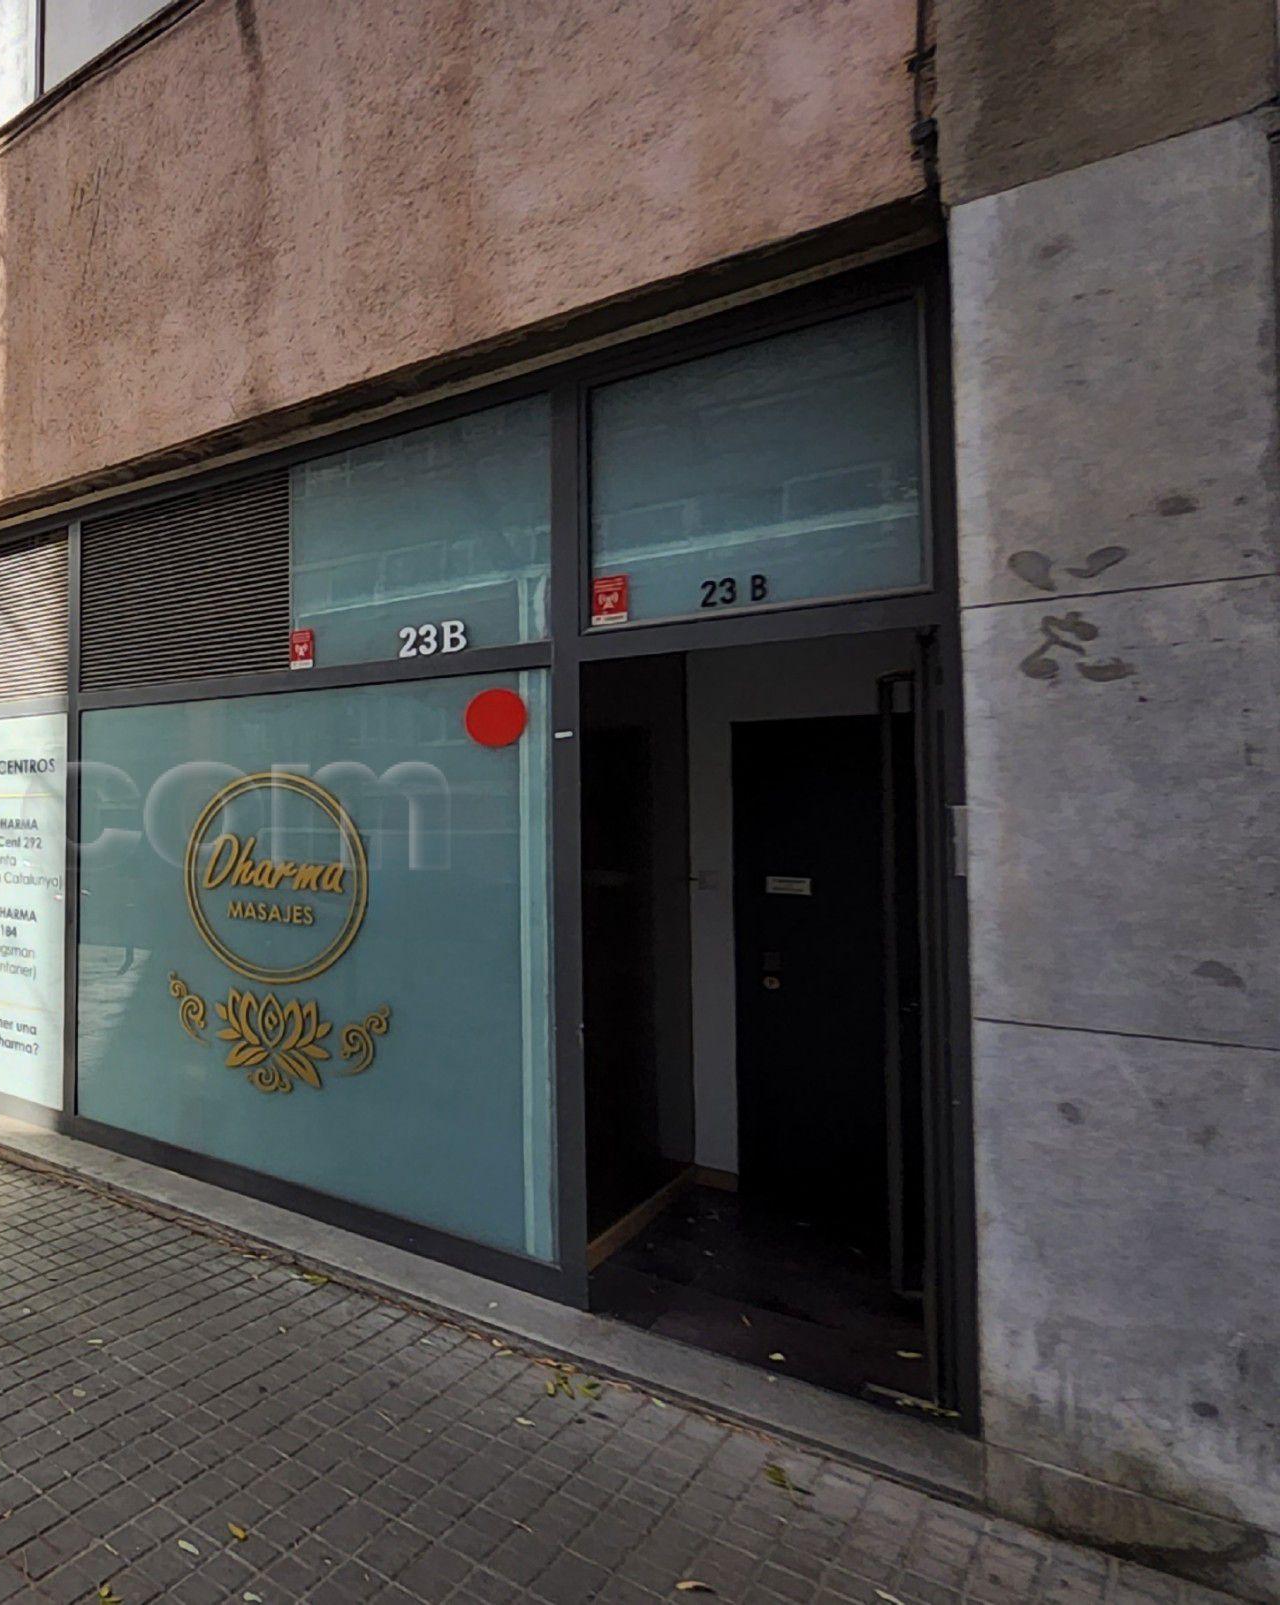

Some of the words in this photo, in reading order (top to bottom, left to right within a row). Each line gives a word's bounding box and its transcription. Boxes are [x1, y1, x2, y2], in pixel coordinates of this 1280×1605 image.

[701, 576, 737, 608] 23
[751, 574, 767, 602] B
[399, 620, 468, 659] 23B
[23, 836, 42, 849] 292
[203, 833, 344, 894] Dharma
[4, 871, 63, 890] Catalunya)
[227, 901, 314, 925] MASAJES
[1, 924, 18, 938] 184
[16, 1022, 38, 1036] una
